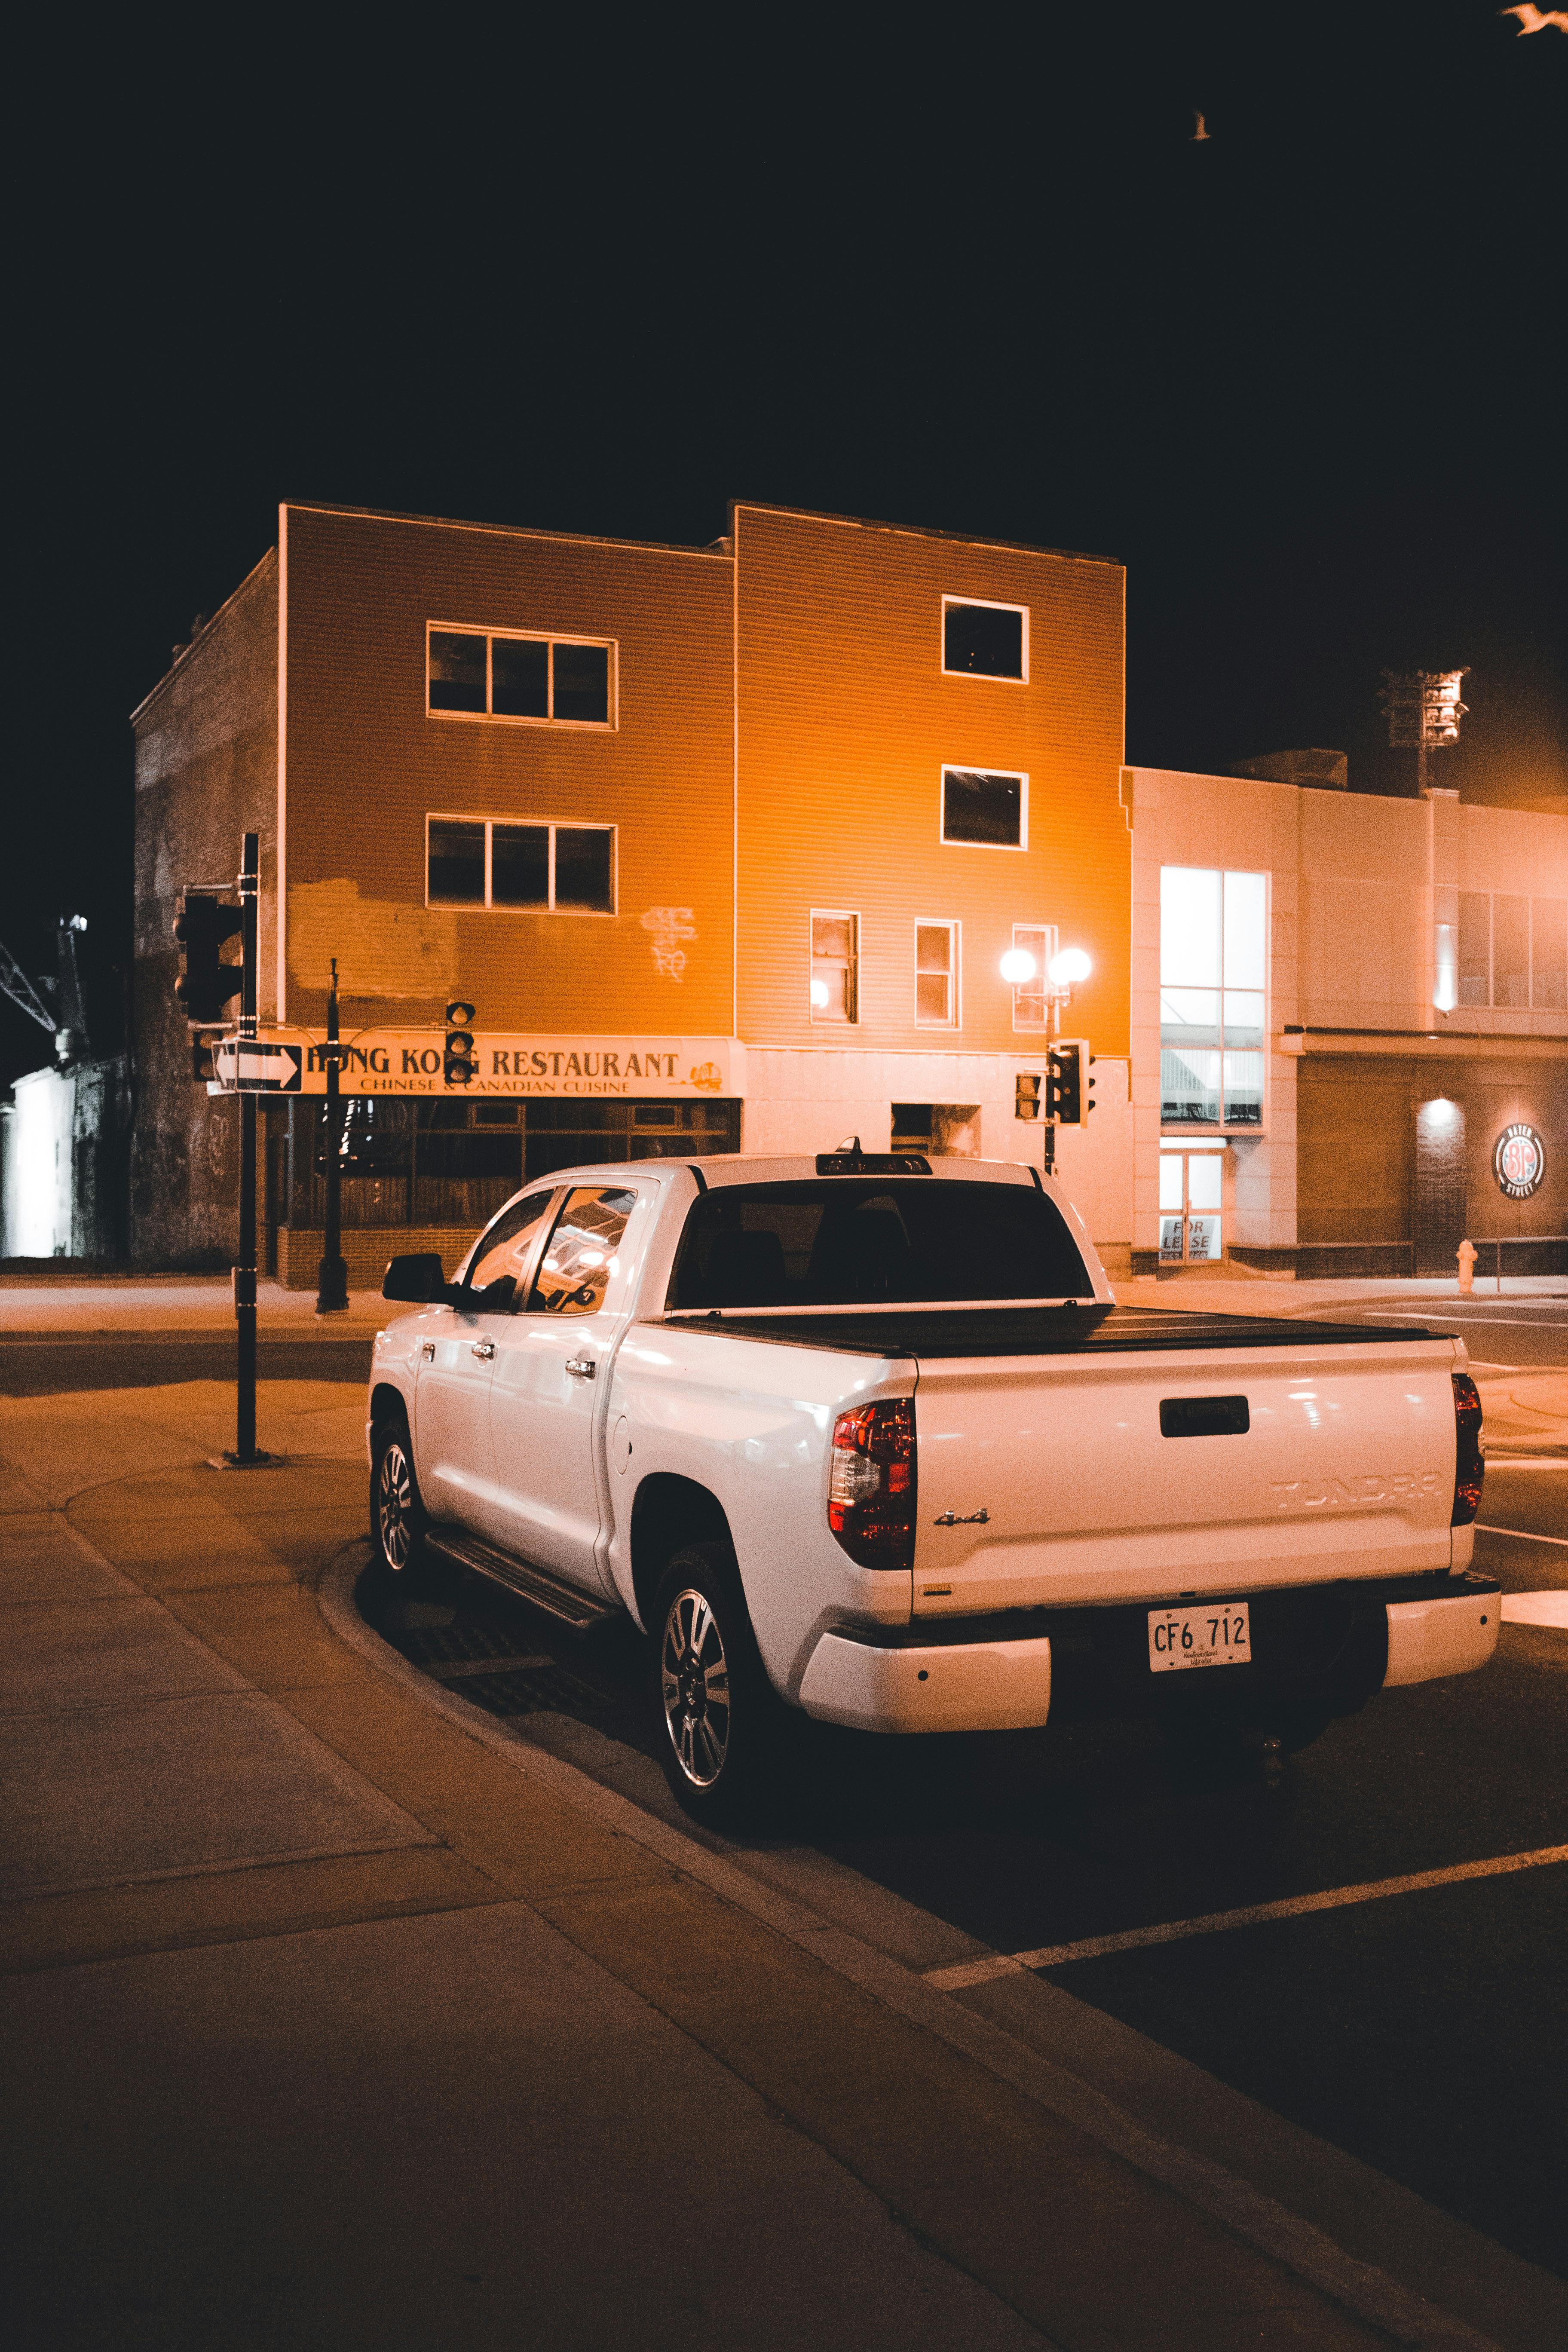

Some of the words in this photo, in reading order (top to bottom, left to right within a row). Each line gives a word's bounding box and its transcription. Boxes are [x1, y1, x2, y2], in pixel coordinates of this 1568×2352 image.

[401, 1048, 480, 1075] KOG
[493, 1050, 679, 1078] RESTAURANT
[360, 1078, 436, 1091] CHINESE
[464, 1081, 556, 1092] CANADIAN
[563, 1081, 630, 1093] CUISINE
[1507, 1124, 1532, 1138] WATER
[1506, 1182, 1533, 1197] STREET
[1163, 1235, 1210, 1249] LESE
[1155, 1622, 1193, 1652] CF6
[1207, 1617, 1246, 1647] 712
